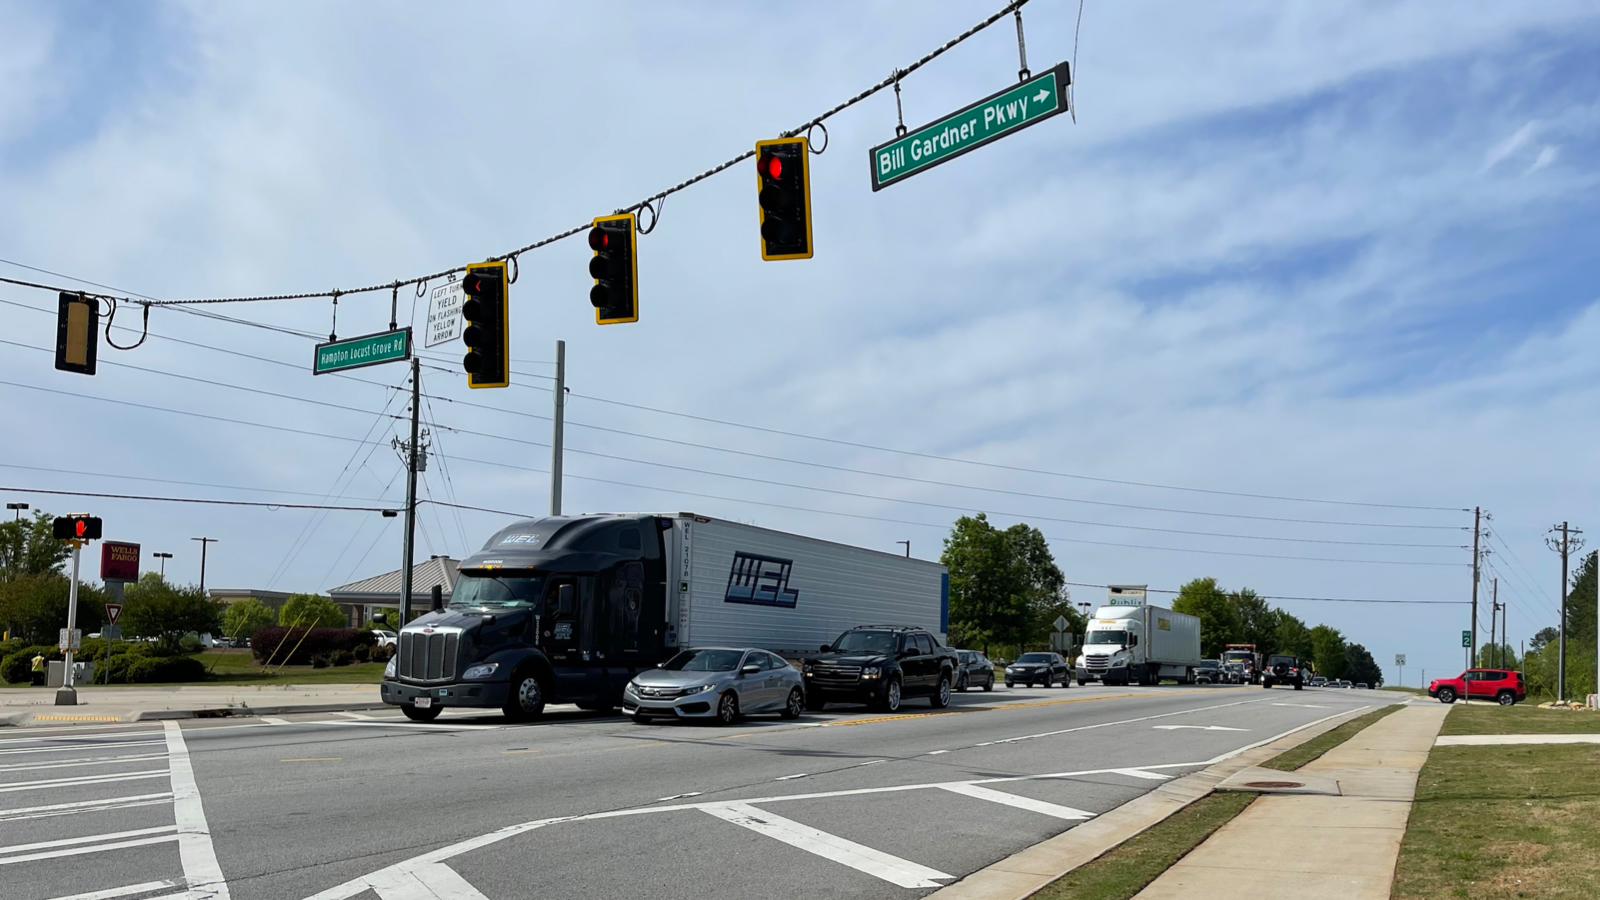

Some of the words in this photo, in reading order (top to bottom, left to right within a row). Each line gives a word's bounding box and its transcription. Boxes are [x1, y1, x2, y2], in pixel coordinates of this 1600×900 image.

[880, 146, 906, 175] Bill
[910, 118, 977, 161] Gardner
[983, 96, 1028, 131] Pkwy
[433, 288, 447, 299] LEFT
[449, 283, 463, 294] TURN
[438, 295, 457, 309] YIELD
[429, 314, 437, 323] ON
[438, 306, 462, 320] FLASHING
[433, 318, 456, 331] YELLOW
[433, 329, 453, 342] ARROW
[321, 350, 348, 365] Hampton
[350, 344, 371, 360] Locust
[371, 343, 392, 355] Grove
[393, 337, 403, 351] Rd
[110, 545, 138, 555] WELLS
[110, 553, 138, 562] FARGO
[1463, 637, 1470, 646] 2
